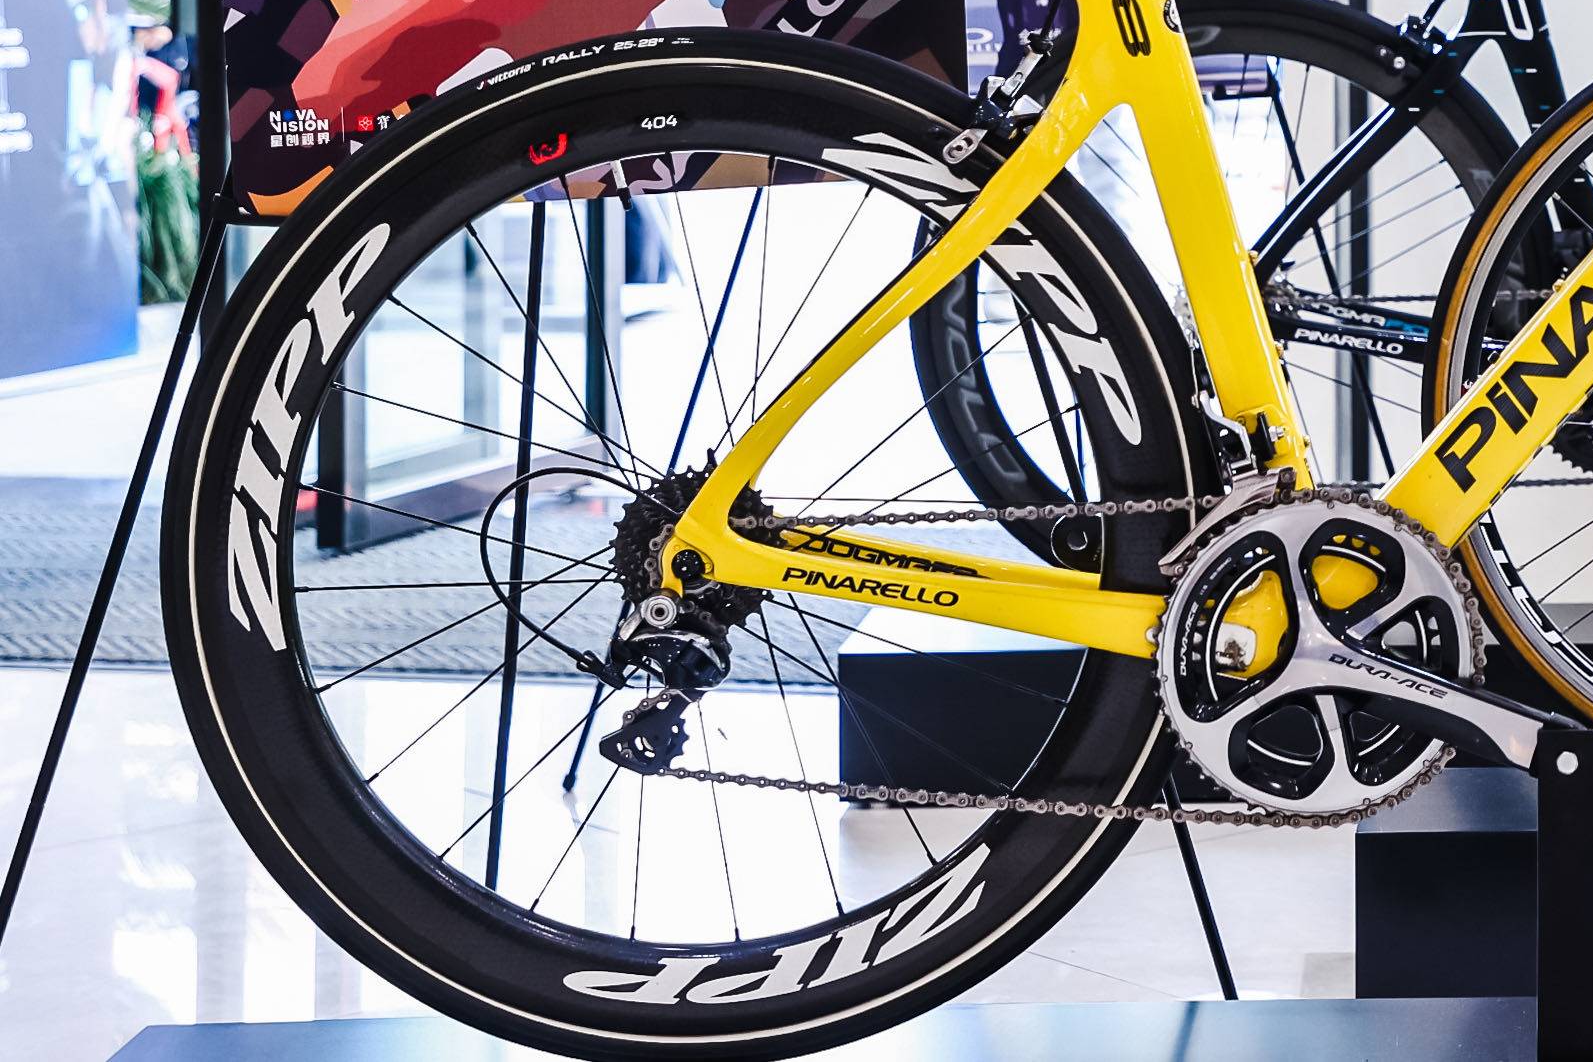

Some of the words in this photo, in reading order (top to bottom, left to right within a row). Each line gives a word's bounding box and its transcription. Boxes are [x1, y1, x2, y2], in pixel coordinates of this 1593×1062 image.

[542, 44, 605, 67] RALLY
[269, 108, 317, 122] NOVA
[270, 120, 330, 133] VISION
[640, 114, 678, 130] 404
[269, 133, 331, 148] 星创视界
[1294, 328, 1404, 355] PINARELLO
[226, 222, 392, 653] ZIPP
[781, 567, 960, 608] PINARELLO
[1327, 653, 1449, 701] DURA-ACE
[563, 842, 992, 1005] ZIPP
